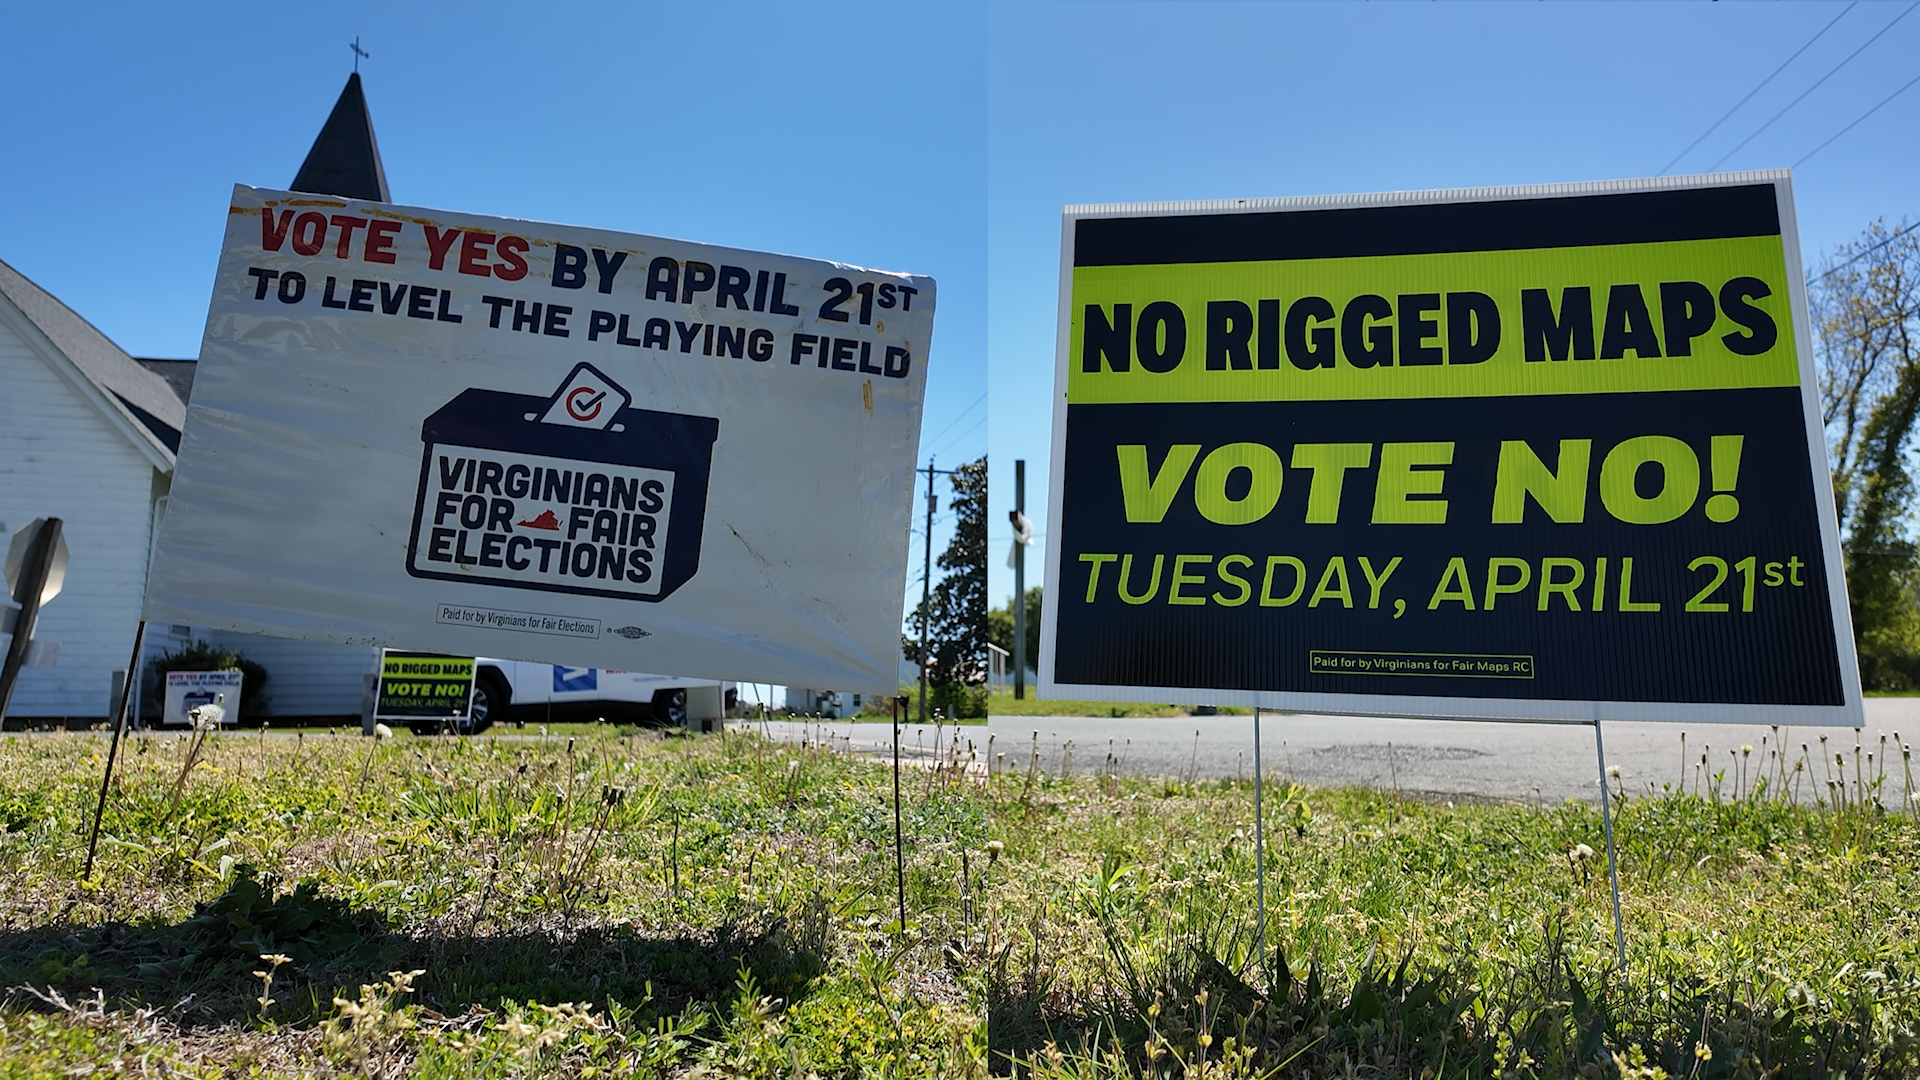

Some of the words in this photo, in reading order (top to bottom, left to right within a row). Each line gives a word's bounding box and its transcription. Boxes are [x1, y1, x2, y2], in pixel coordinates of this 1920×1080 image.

[262, 207, 402, 264] VOTE
[423, 225, 530, 281] YES
[551, 243, 628, 294] BY
[645, 256, 800, 316] APRIL
[818, 277, 918, 325] 21ST
[249, 267, 306, 304] TO
[322, 277, 462, 323] LEVEL
[482, 295, 573, 338] THE
[588, 310, 774, 362] PLAYING
[790, 333, 911, 379] FIELD
[1082, 301, 1187, 373] NO
[1205, 291, 1501, 371] RIGGED
[1521, 276, 1778, 362] MAPS
[439, 455, 665, 513] VIRGINIANS
[1116, 441, 1455, 525] VOTE
[1491, 435, 1744, 524] NO!
[434, 491, 515, 533] FOR
[567, 507, 657, 548] FAIR
[428, 527, 653, 583] ELECTIONS
[1078, 553, 1406, 619] TUESDAY,
[1427, 557, 1661, 612] APRIL
[1685, 555, 1804, 612] 21st
[442, 607, 461, 620] Paid
[462, 609, 474, 621] for
[475, 610, 487, 624] by
[487, 612, 527, 628] Virginians
[528, 616, 541, 629] for
[541, 617, 557, 630] Fair
[558, 620, 595, 634] Elections
[384, 663, 400, 674] NO
[401, 663, 441, 675] RIGGED
[442, 664, 472, 676] MAPS
[386, 682, 432, 696] VOTE
[434, 684, 466, 697] NO!
[1313, 656, 1338, 667] Paid
[1340, 657, 1357, 668] for
[1358, 658, 1372, 671] by
[1373, 658, 1431, 672] Virginians
[1432, 659, 1450, 671] for
[1452, 660, 1475, 671] Fair
[1477, 661, 1510, 673] Maps
[1512, 661, 1530, 673] RC
[424, 698, 452, 708] APRIL
